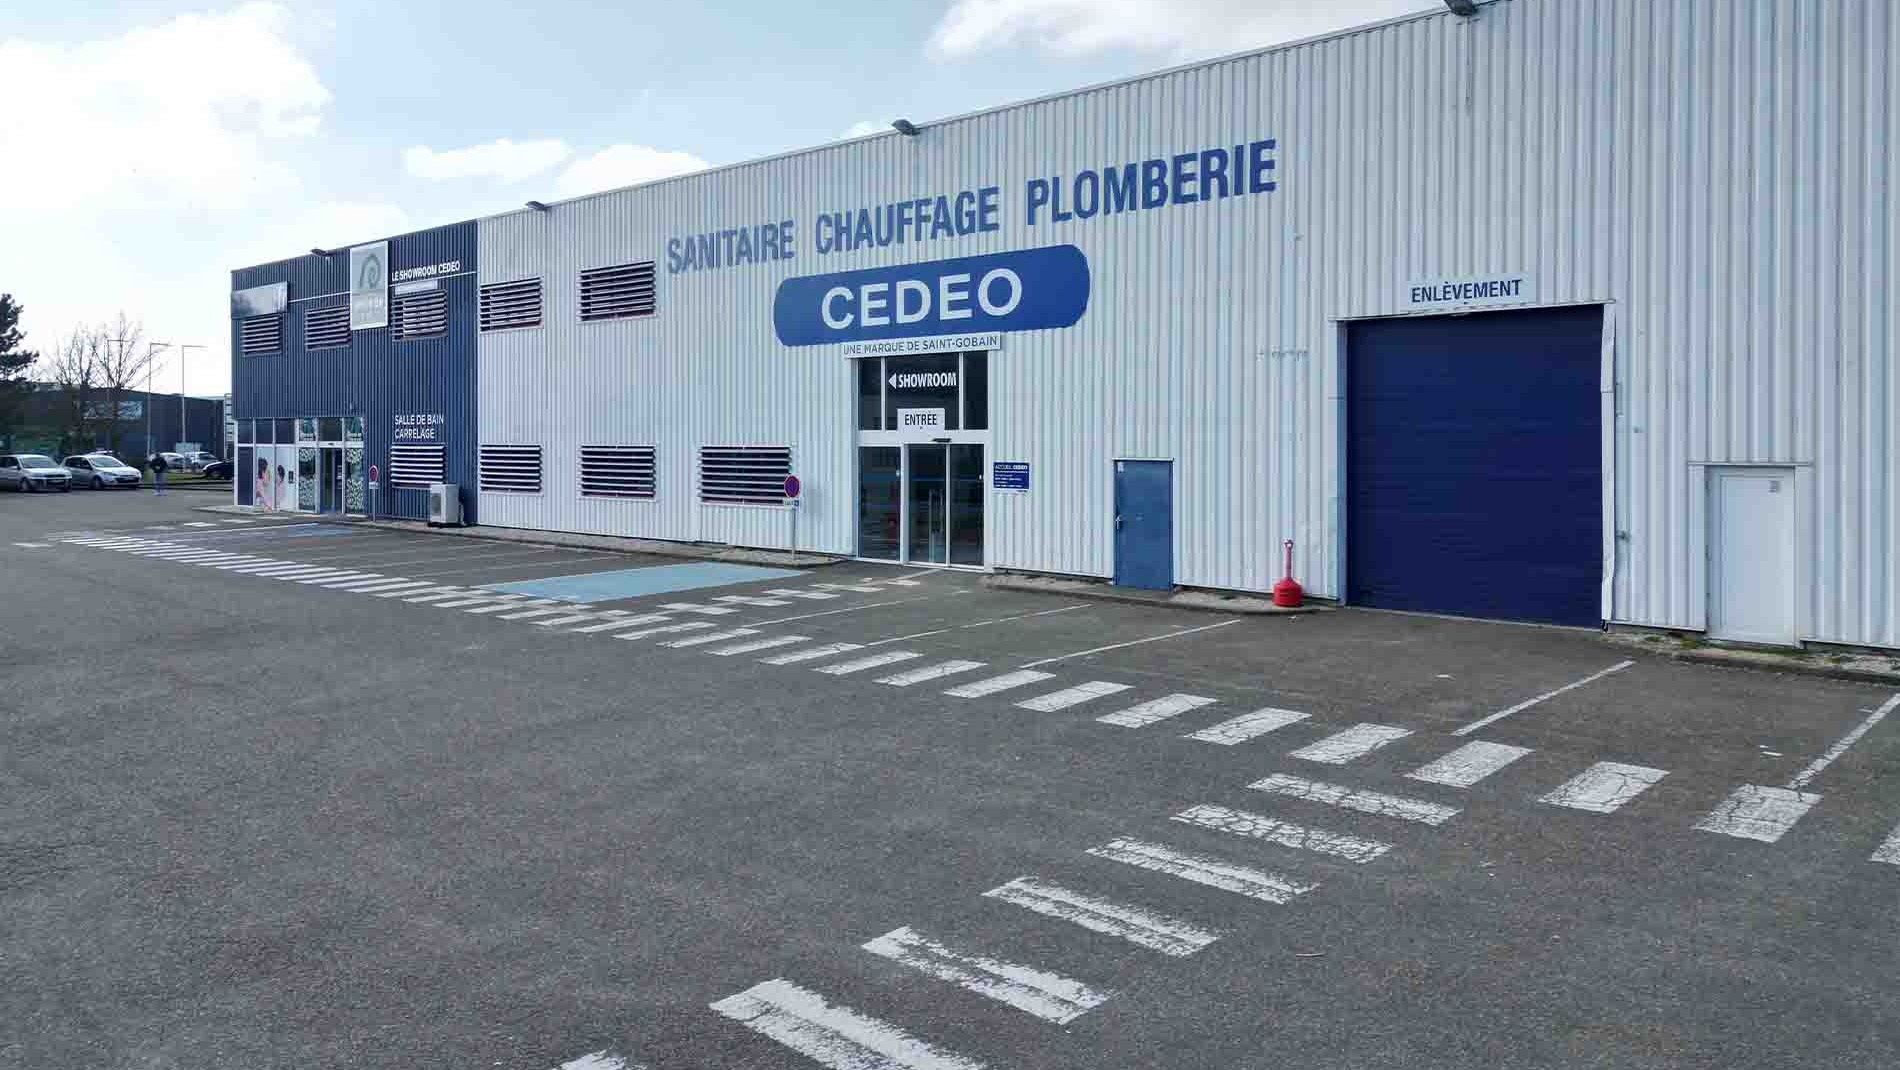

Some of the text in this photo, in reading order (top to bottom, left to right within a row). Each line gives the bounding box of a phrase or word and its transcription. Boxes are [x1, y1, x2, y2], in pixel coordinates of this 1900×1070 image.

[667, 139, 1276, 273] SANITAIRE CHAUFFAGE PLOMBERIE
[391, 260, 461, 282] LE SHOWROOM CEDEO
[821, 268, 1023, 330] CEDEO
[1411, 279, 1522, 303] ENLÈVEMENT
[843, 335, 997, 355] UNE MARQUE DE SAINT-GOBAIN
[898, 372, 957, 388] SHOWROOM
[394, 413, 444, 425] SALLE DE BAIN
[394, 428, 435, 439] CARRELAGE
